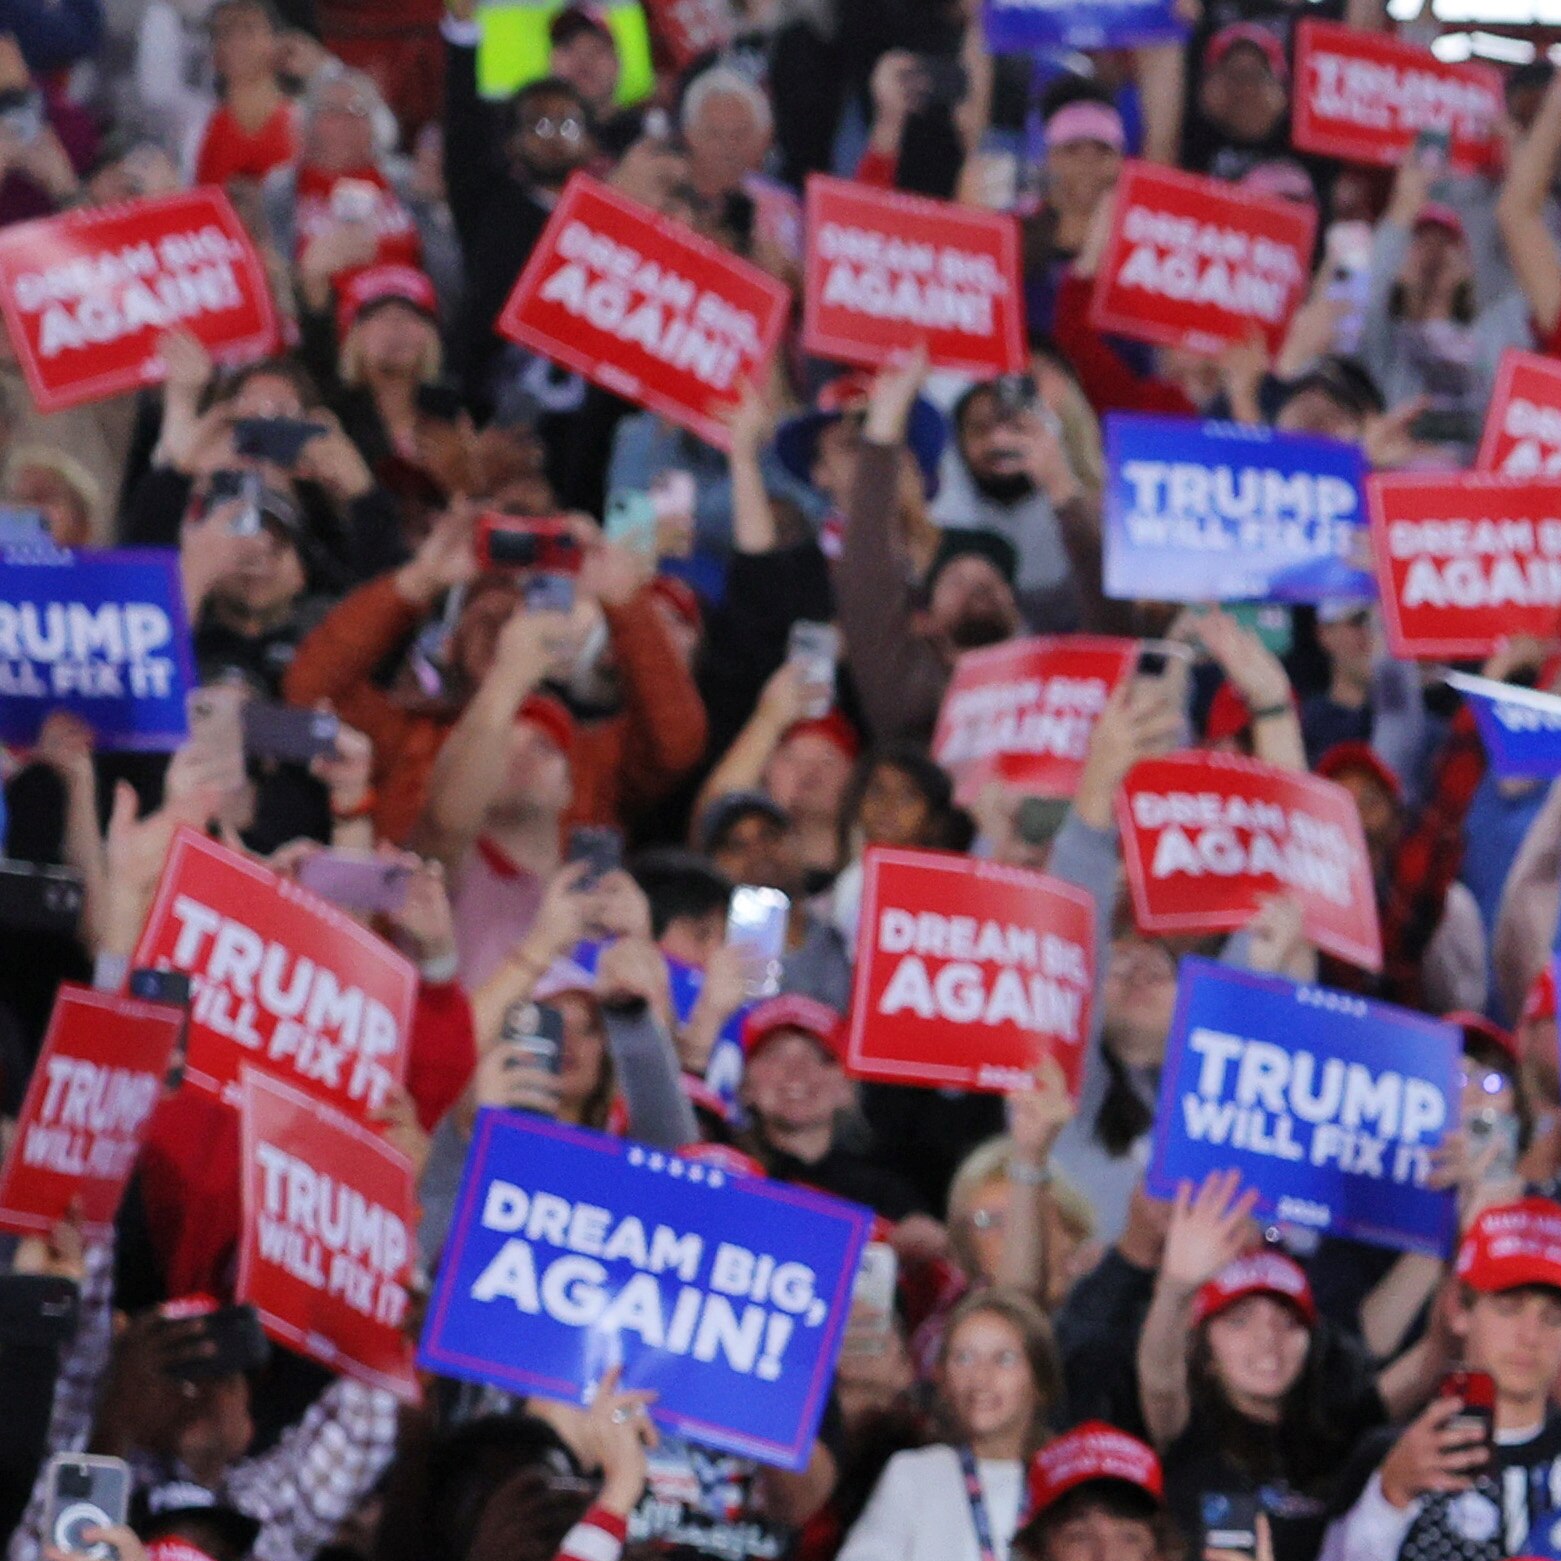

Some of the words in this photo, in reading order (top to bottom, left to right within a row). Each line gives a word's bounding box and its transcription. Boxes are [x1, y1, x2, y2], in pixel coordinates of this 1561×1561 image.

[553, 221, 698, 318] DREAM
[819, 221, 936, 277] DREAM
[1123, 206, 1247, 262] DREAM
[14, 243, 157, 314] DREAM
[38, 264, 245, 356] AGAIN!
[822, 263, 995, 336] AGAIN!
[1119, 247, 1290, 323] AGAIN!
[539, 261, 743, 391] AGAIN!
[1122, 460, 1358, 519] TRUMP
[1388, 520, 1534, 559] DREAM
[0, 600, 173, 662] RUMP
[53, 662, 124, 698] FIX
[129, 656, 174, 698] IT
[1132, 789, 1284, 836] DREAM
[1154, 828, 1356, 906] AGAIN!
[172, 894, 399, 1057] TRUMP
[879, 907, 1038, 969] DREAM
[879, 959, 1085, 1044] AGAIN!
[42, 1054, 161, 1135] TRUMP
[268, 1016, 348, 1089] FIX
[347, 1053, 394, 1110] IT
[1189, 1026, 1448, 1144] TRUMP
[23, 1123, 87, 1176] WILL
[1181, 1091, 1302, 1162] WILL
[1310, 1120, 1389, 1180] FIX
[1396, 1146, 1433, 1190] IT
[256, 1143, 408, 1267] TRUMP
[257, 1220, 327, 1290] WILL
[329, 1256, 376, 1314] FIX
[481, 1179, 703, 1280] DREAM
[710, 1242, 828, 1330] BIG,
[468, 1240, 796, 1382] AGAIN!
